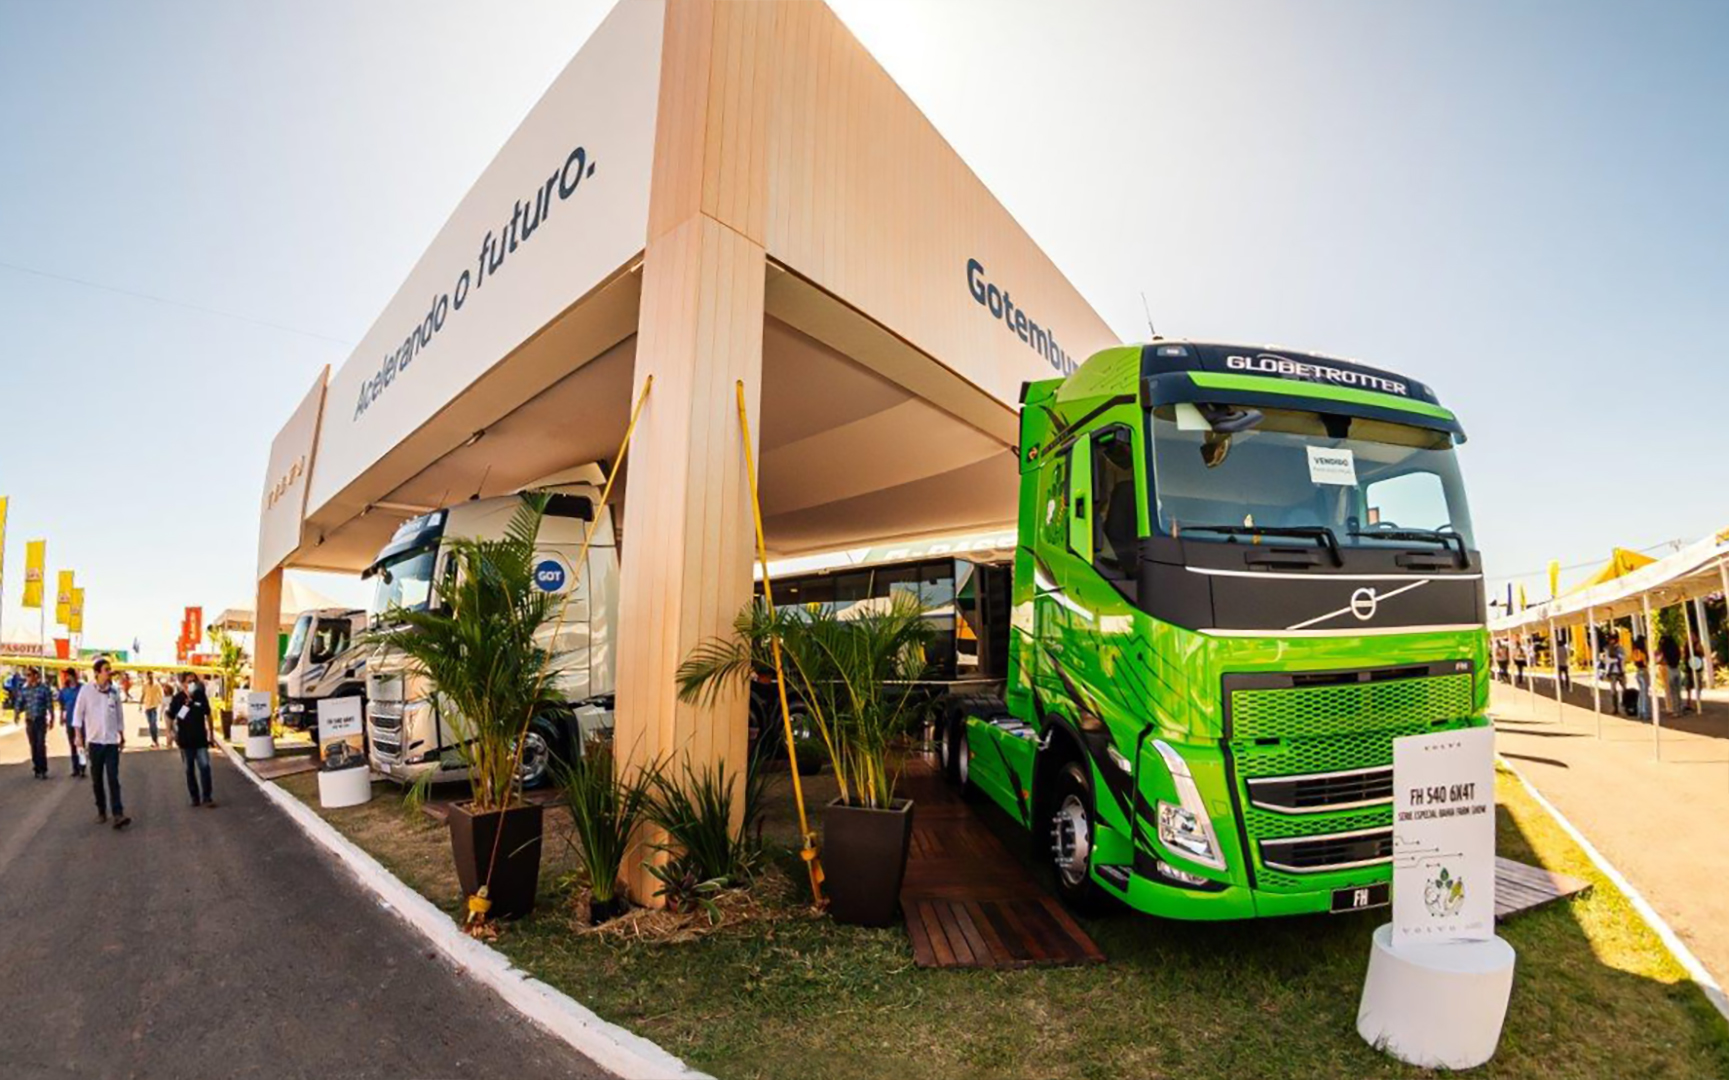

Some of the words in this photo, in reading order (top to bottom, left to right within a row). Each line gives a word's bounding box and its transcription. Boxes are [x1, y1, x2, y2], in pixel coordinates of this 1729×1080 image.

[353, 293, 449, 422] Acelerando
[452, 269, 470, 311] o
[476, 146, 596, 289] futuro.
[1226, 354, 1407, 396] GLOBETROTTER
[1313, 456, 1349, 467] VENDIDO
[538, 570, 563, 582] GOT
[1410, 788, 1424, 806] FH
[1426, 786, 1447, 804] 540
[1449, 783, 1475, 802] 6X4T
[1353, 888, 1369, 907] FH
